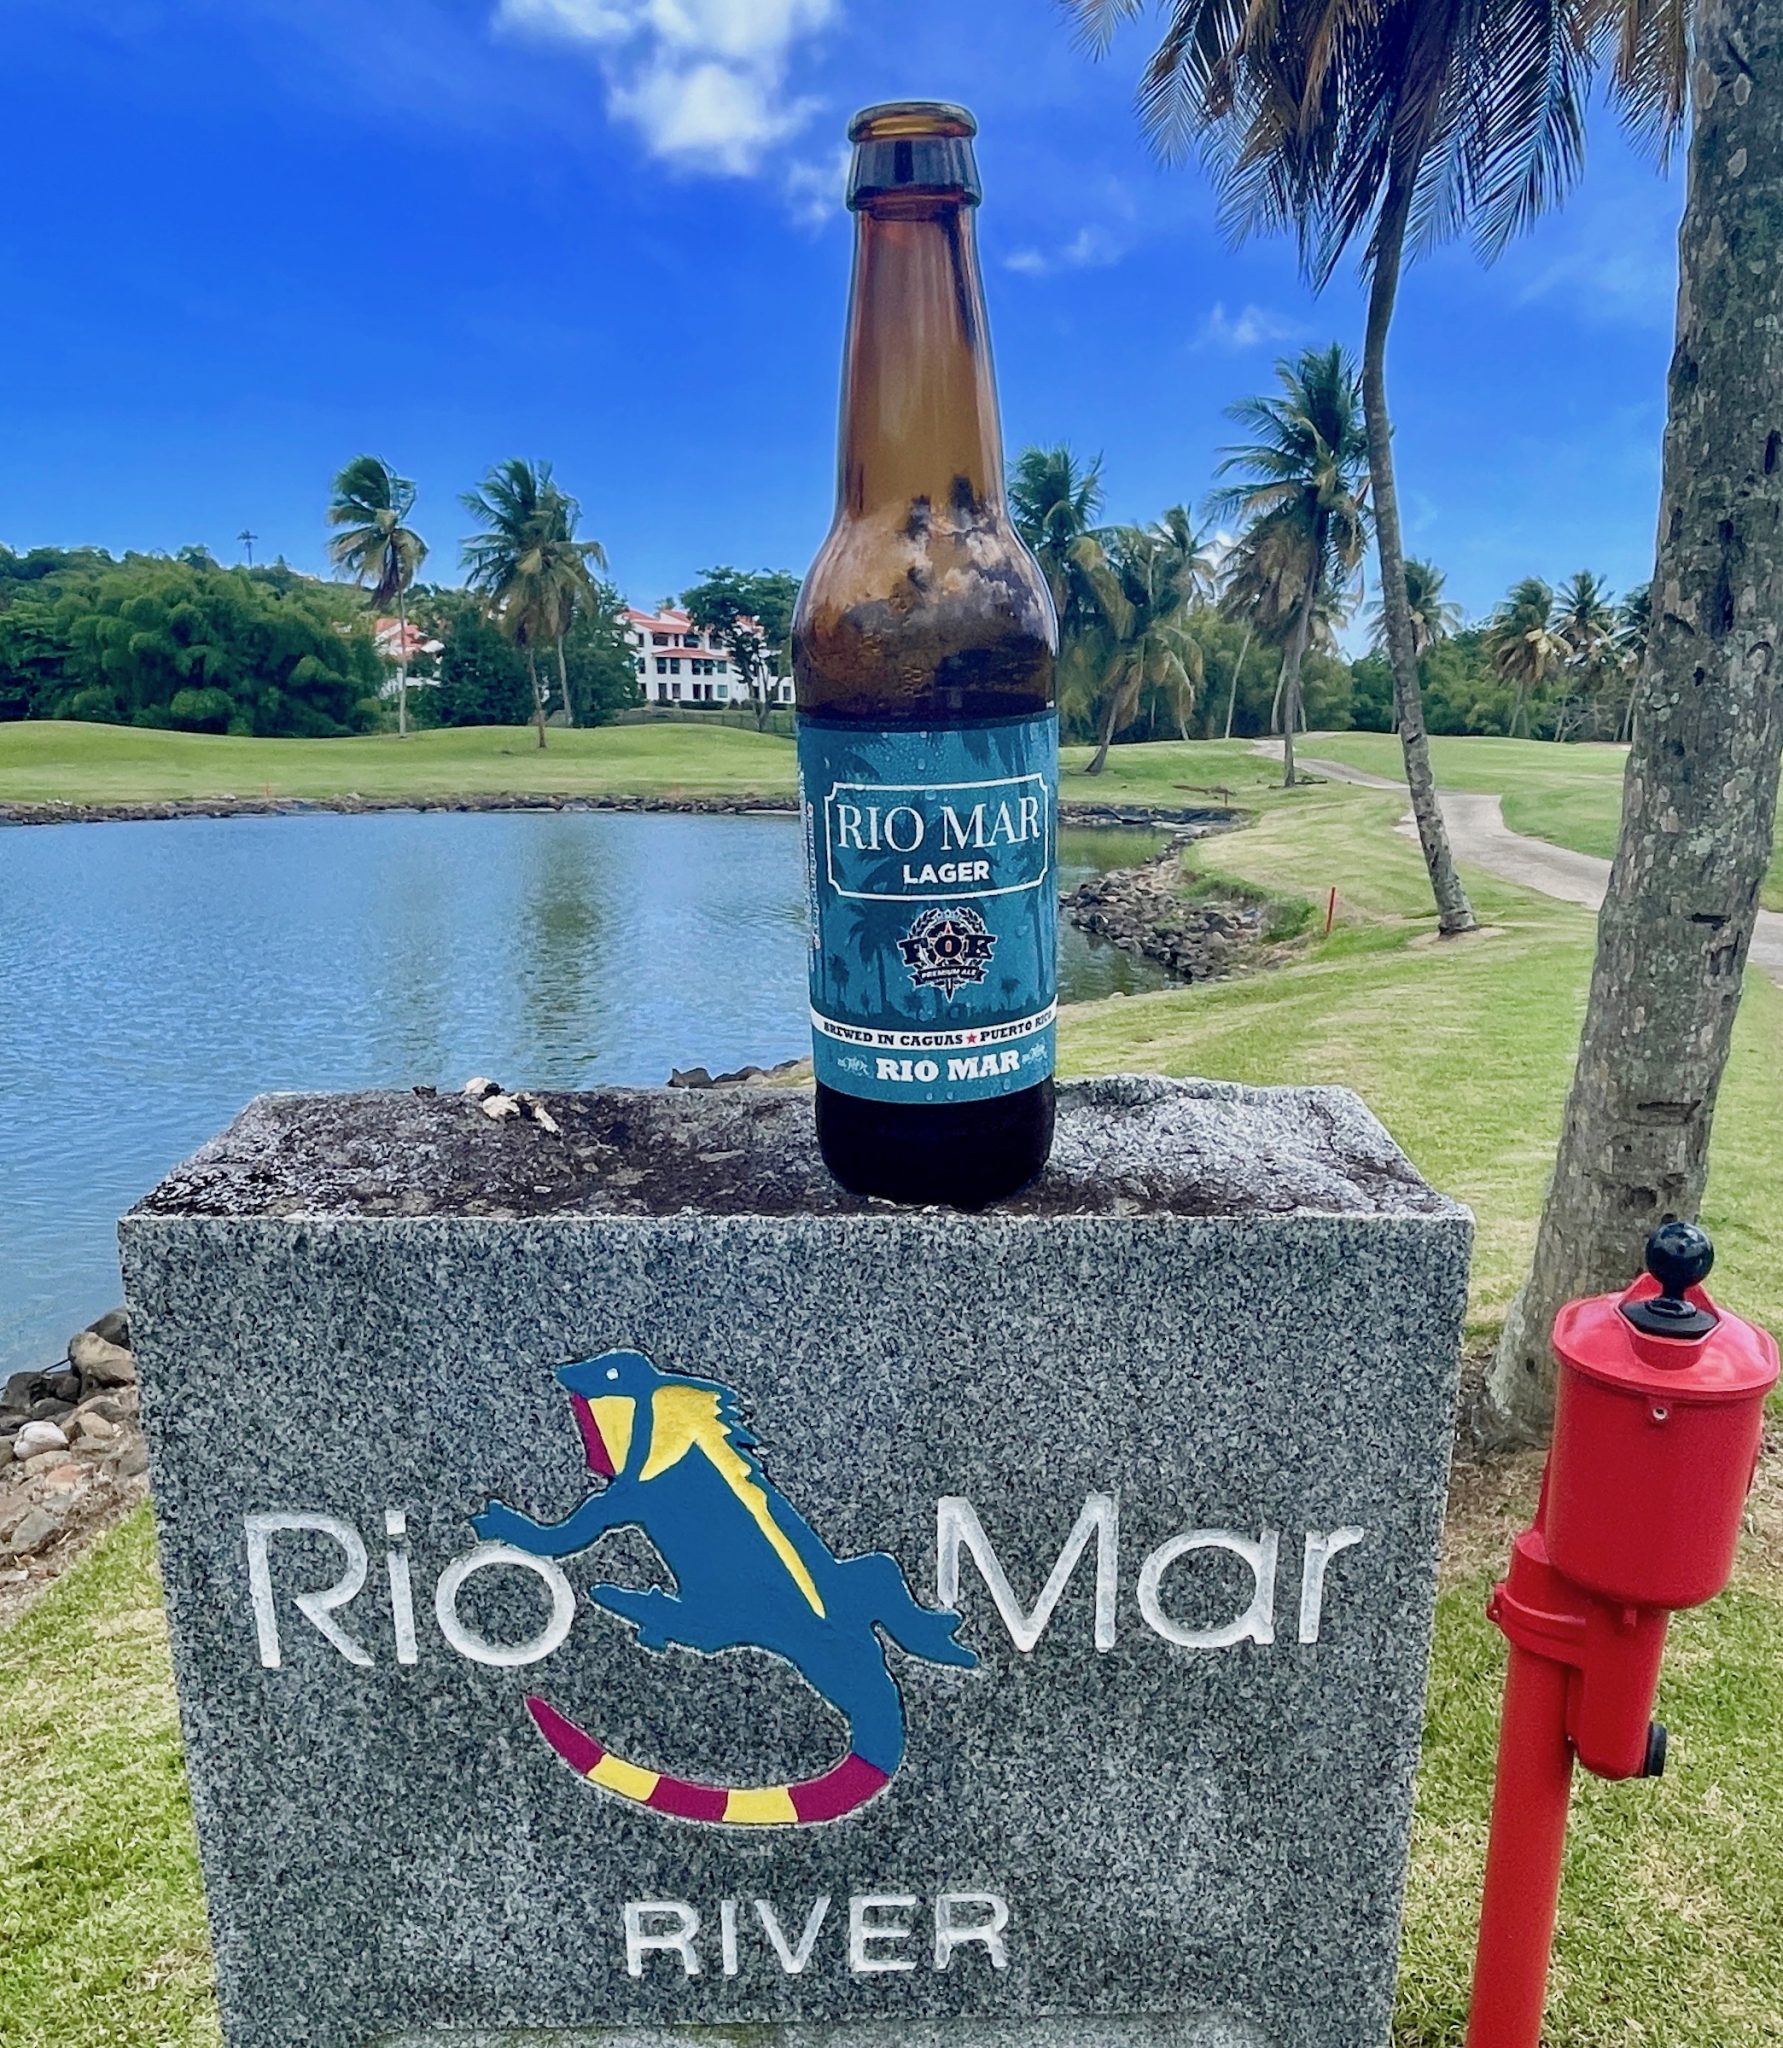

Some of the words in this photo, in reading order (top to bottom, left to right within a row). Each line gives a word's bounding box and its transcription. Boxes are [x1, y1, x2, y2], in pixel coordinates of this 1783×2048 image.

[836, 803, 924, 851] RIO
[939, 796, 1041, 850] MAR
[902, 860, 989, 884] LAGER
[897, 933, 998, 967] FOK
[921, 968, 961, 979] PREMIUM
[961, 968, 977, 976] ALE
[823, 1021, 873, 1042] BREWED
[877, 1033, 894, 1045] IN
[900, 1034, 963, 1046] CAGUAS
[980, 1020, 1032, 1042] PUERTO
[875, 1057, 939, 1082] RIO
[947, 1049, 1021, 1082] MAR
[244, 1509, 574, 1668] Rio
[937, 1494, 1365, 1652] Mar
[624, 1893, 1010, 1980] RIVER
